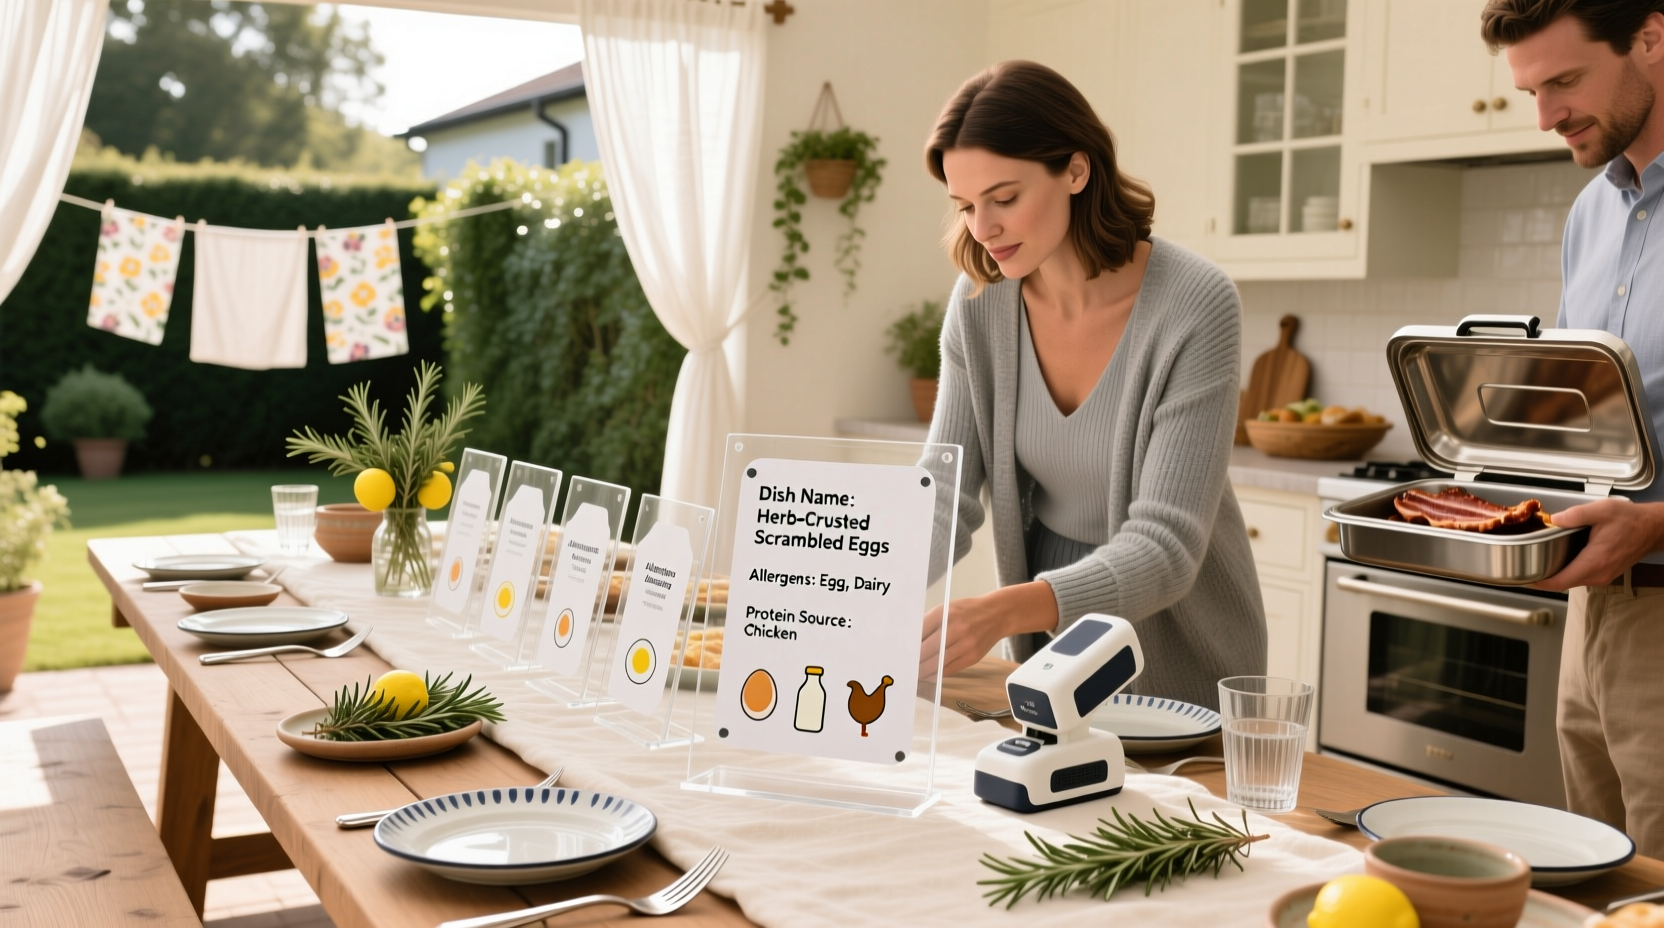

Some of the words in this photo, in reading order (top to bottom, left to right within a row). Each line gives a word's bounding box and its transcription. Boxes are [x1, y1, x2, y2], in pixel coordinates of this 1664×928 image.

[758, 486, 796, 504] Dish
[801, 488, 855, 508] Name:
[757, 508, 871, 531] Herb-Crusted
[754, 530, 844, 551] Scrambled
[848, 536, 890, 557] Eggs
[748, 568, 816, 587] Allergens:
[820, 573, 850, 592] Egg,
[854, 576, 891, 596] Dairy
[745, 606, 796, 623] Protein
[798, 610, 852, 628] Source:
[744, 623, 798, 641] Chicken
